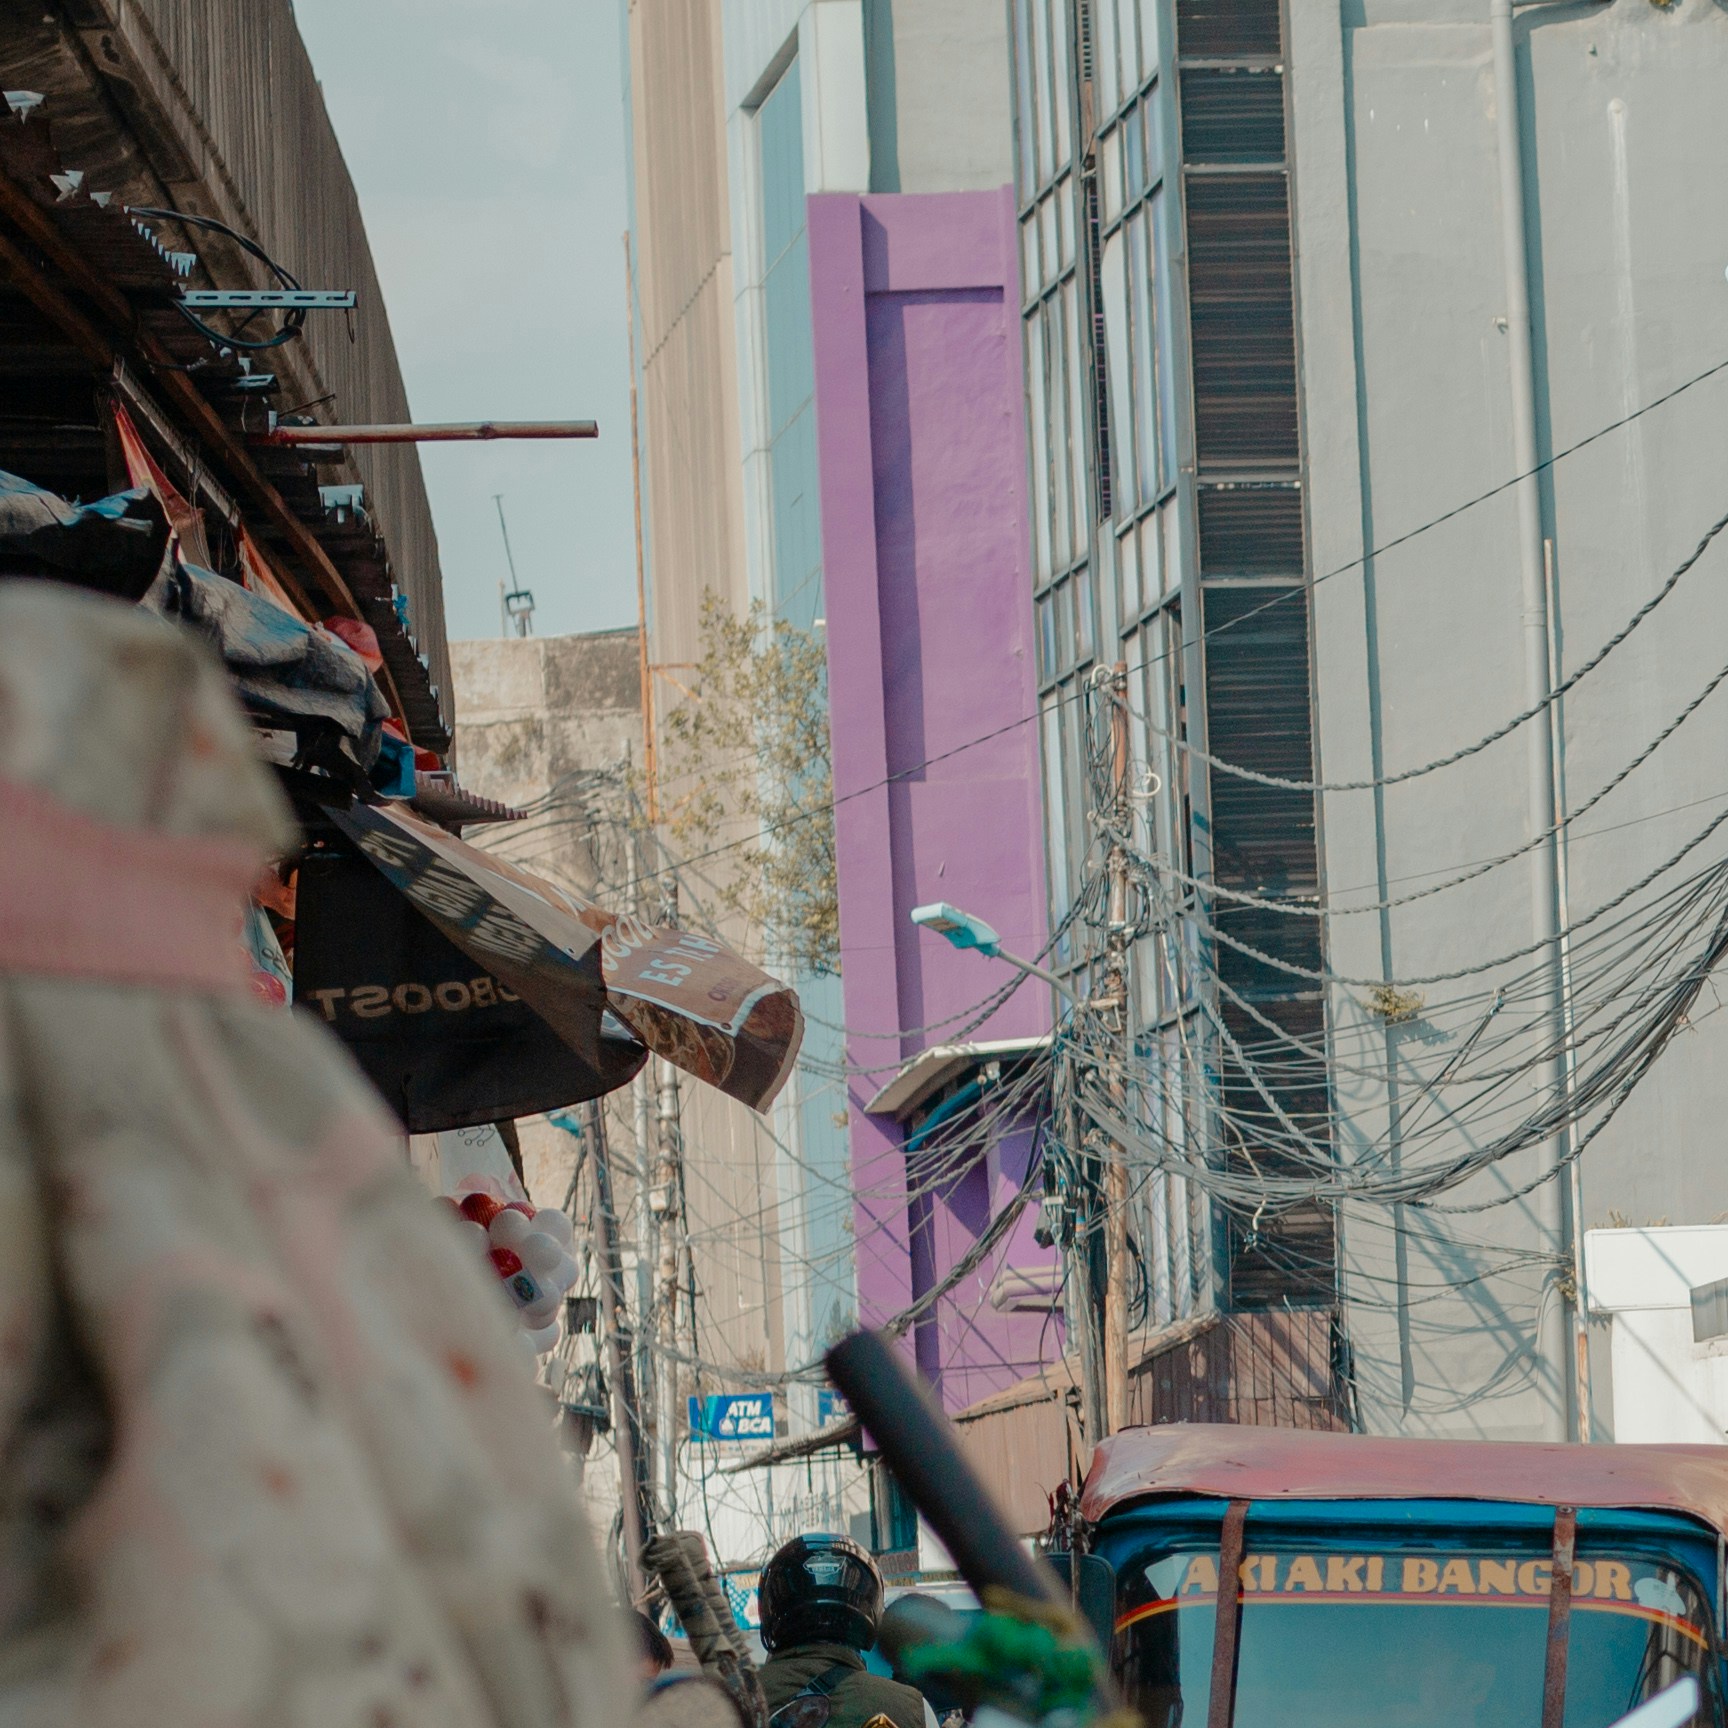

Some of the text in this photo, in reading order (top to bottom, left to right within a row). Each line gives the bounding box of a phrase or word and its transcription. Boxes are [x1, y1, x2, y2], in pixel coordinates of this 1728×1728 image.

[727, 1400, 762, 1417] ATM
[737, 1416, 772, 1435] BCA
[1284, 1555, 1384, 1593] AKI
[1402, 1557, 1632, 1600] BANGOR
